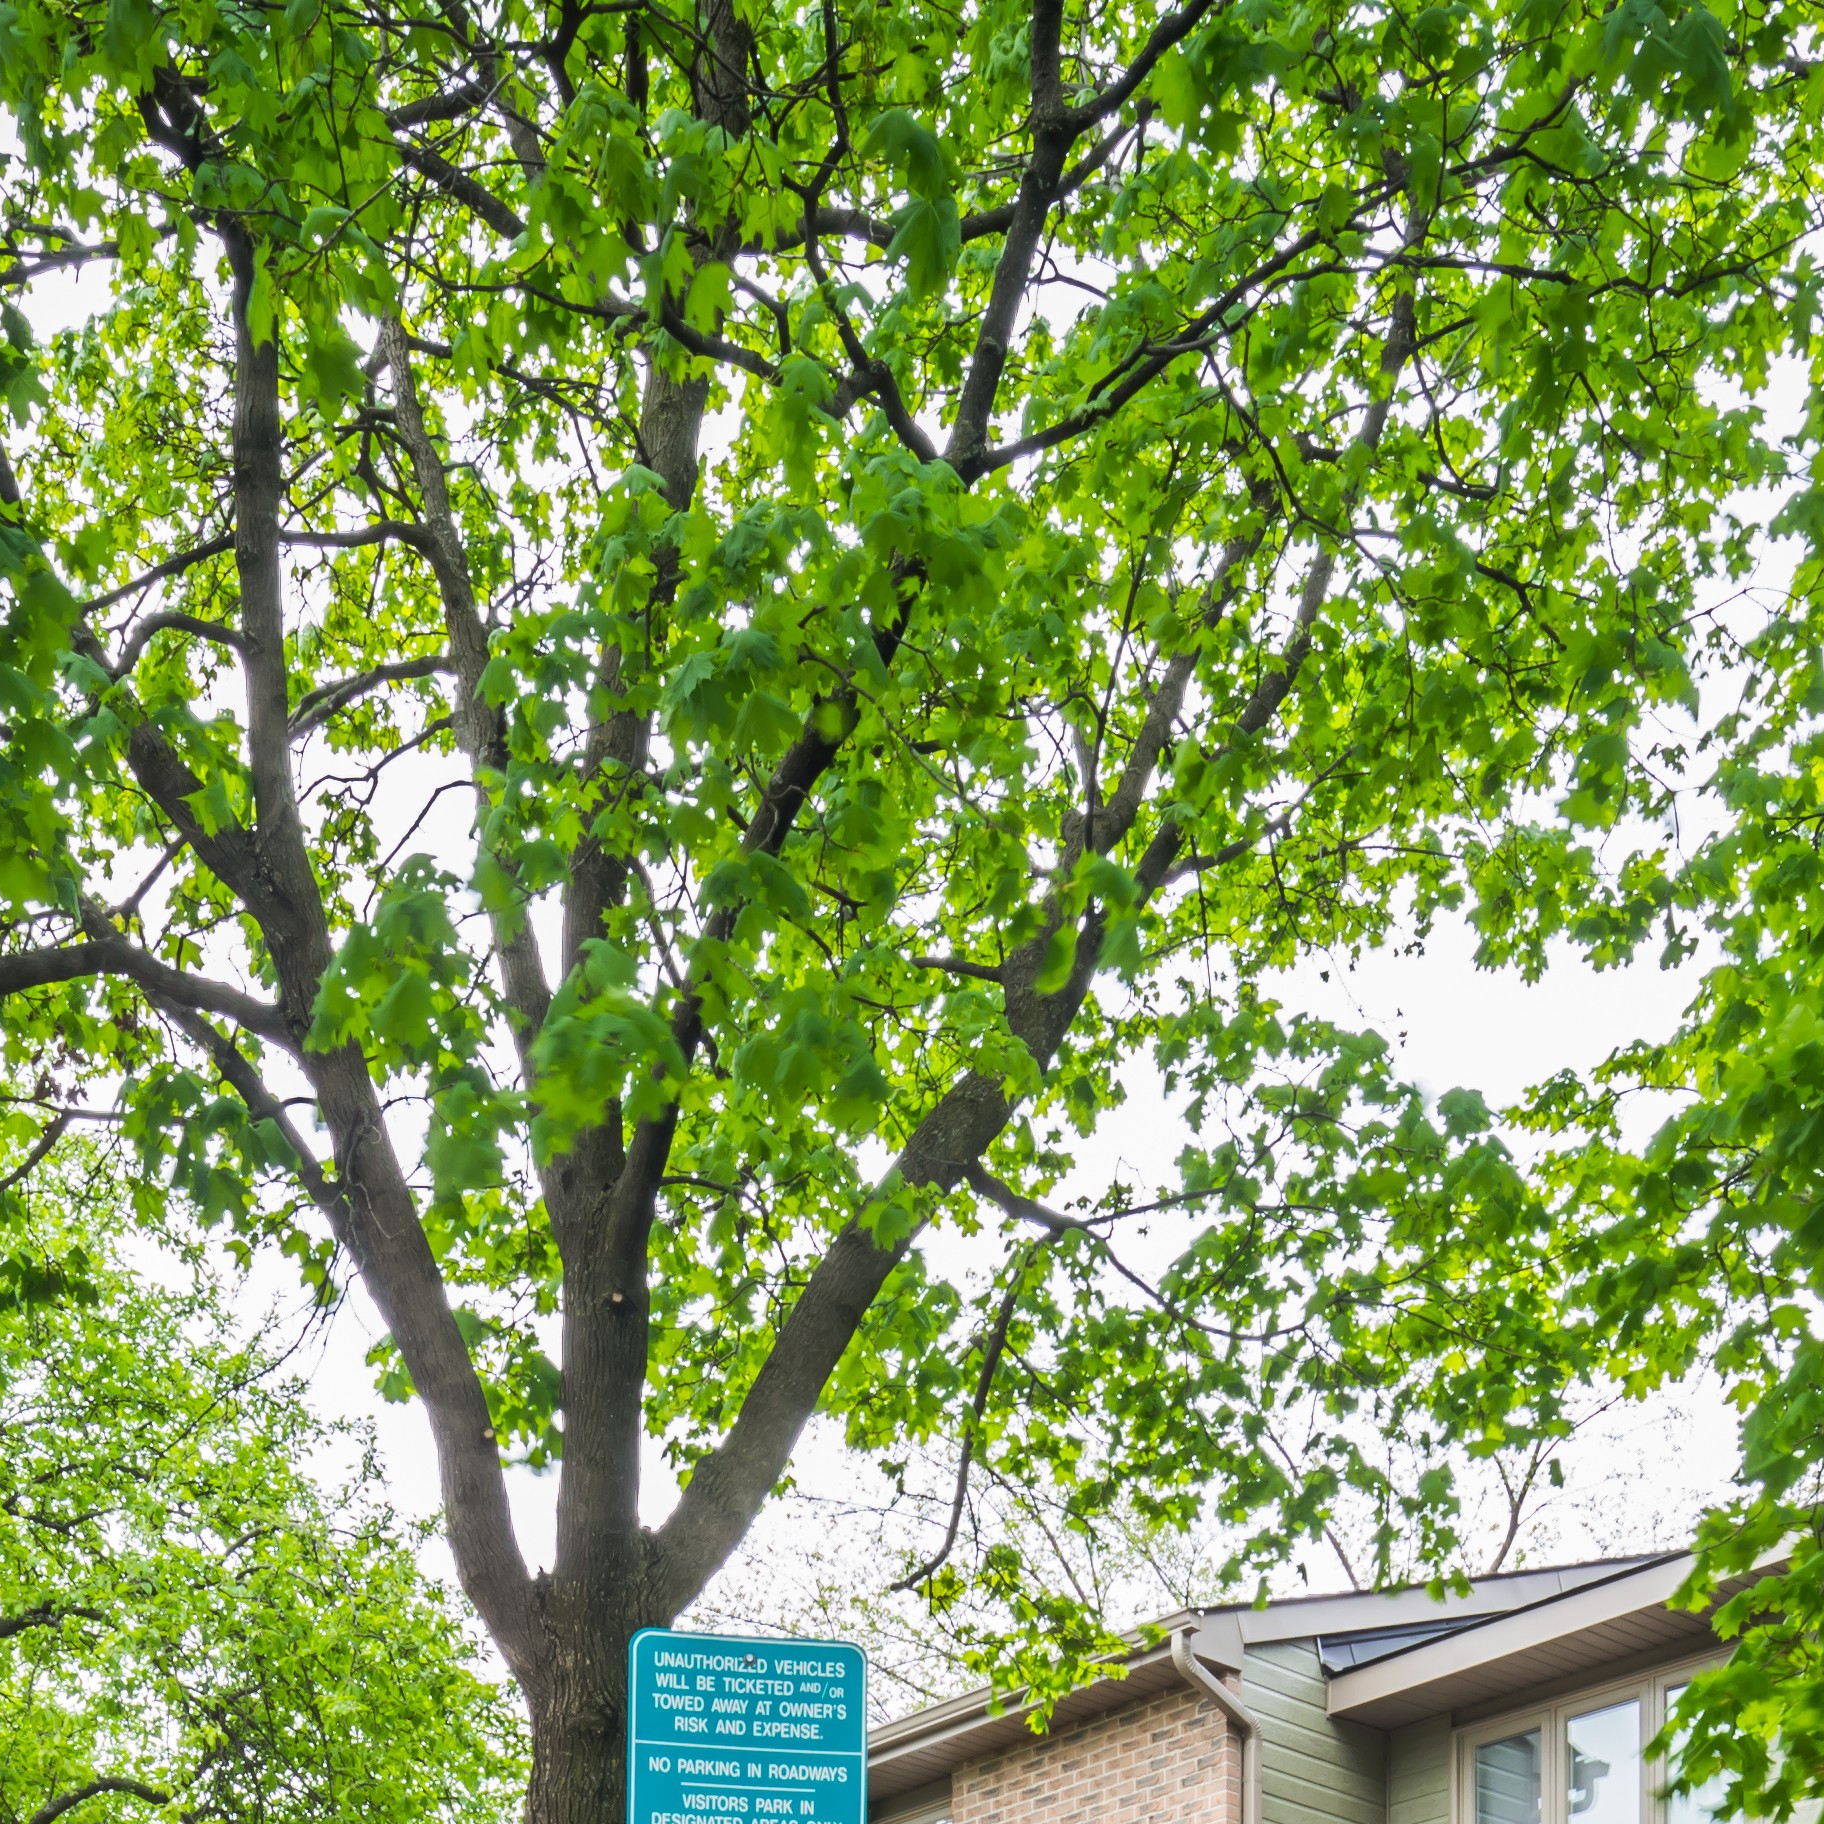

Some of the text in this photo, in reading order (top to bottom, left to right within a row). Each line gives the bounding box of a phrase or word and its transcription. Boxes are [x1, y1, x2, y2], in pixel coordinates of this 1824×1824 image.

[774, 1659, 845, 1678] VEHICLES
[655, 1672, 689, 1690] WILL
[696, 1676, 715, 1691] BE
[723, 1677, 794, 1696] TICKETED
[652, 1692, 847, 1720] TOWED AWAY AT OWNER'S
[674, 1716, 824, 1740] RISK AND EXPENSE.
[649, 1756, 847, 1783] NO PARKING IN ROADWAYS
[682, 1793, 815, 1816] VISITORS PARK IN
